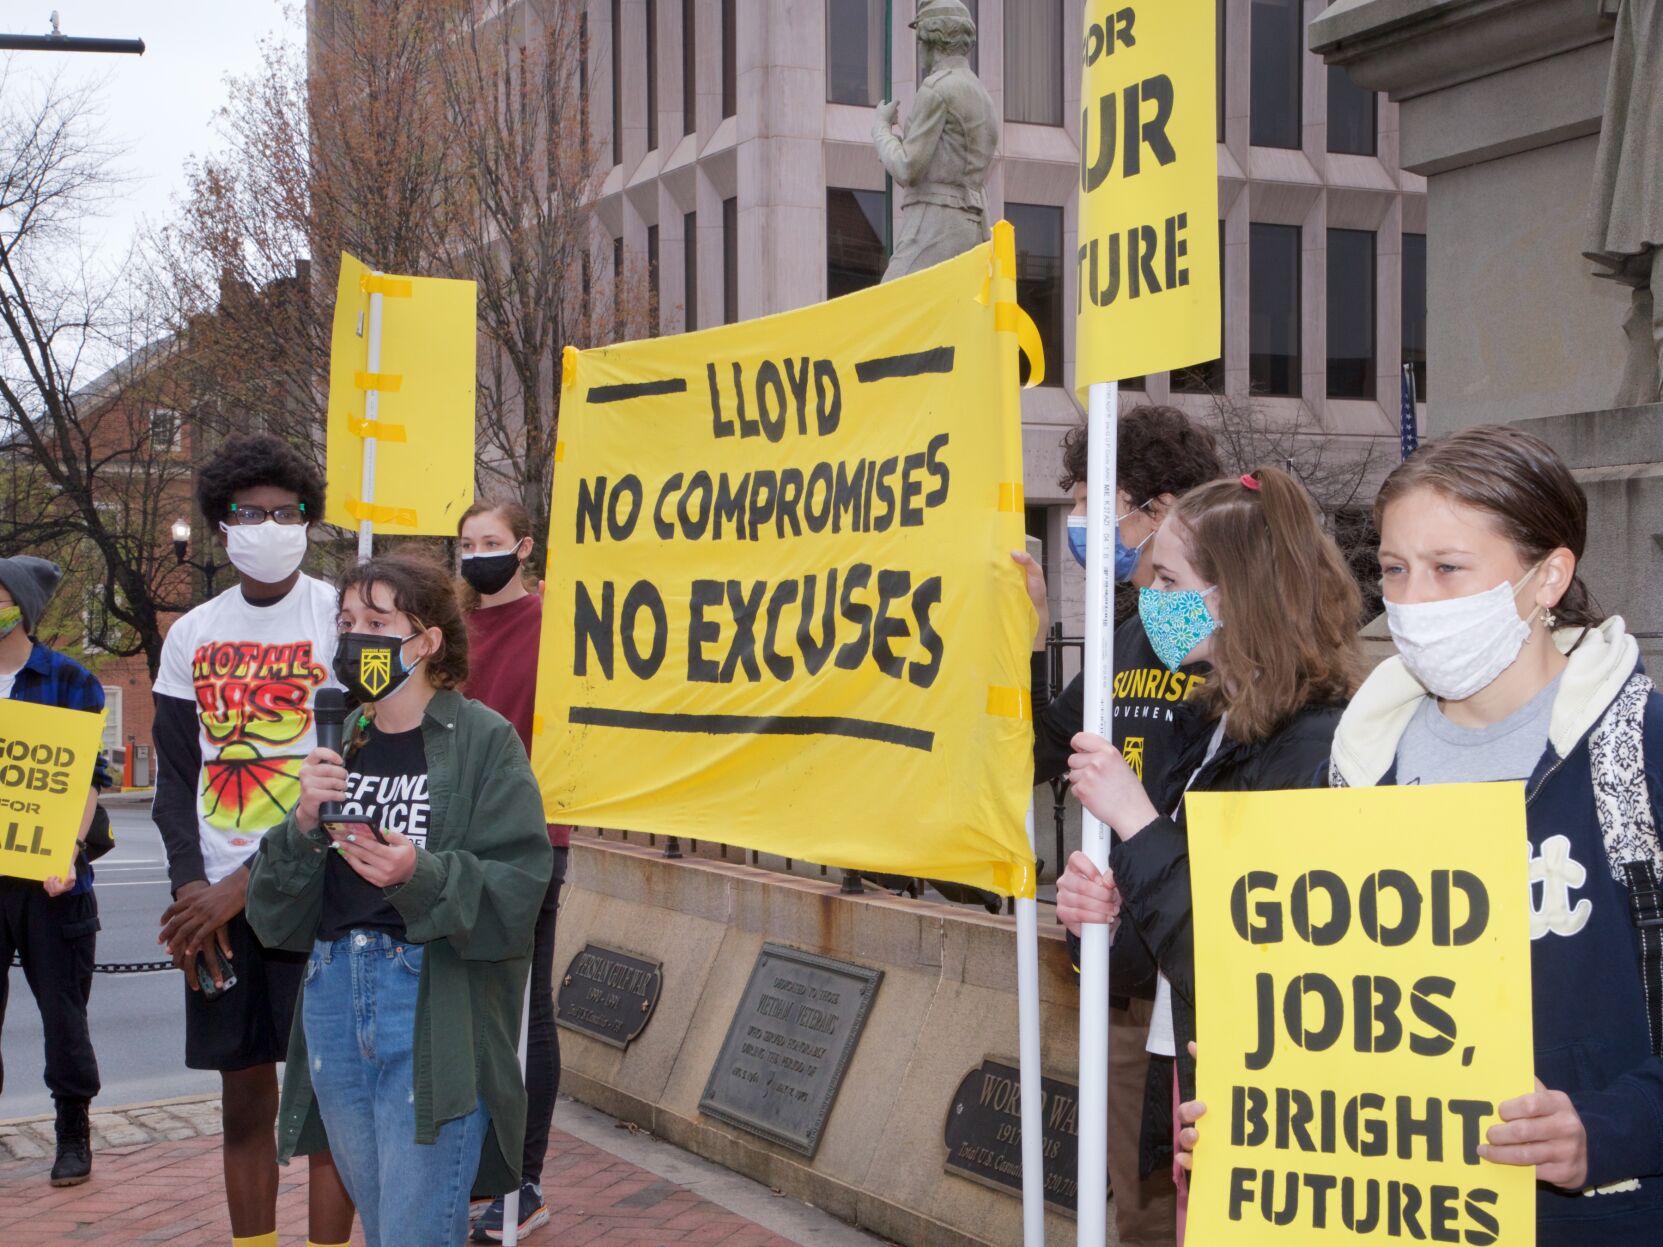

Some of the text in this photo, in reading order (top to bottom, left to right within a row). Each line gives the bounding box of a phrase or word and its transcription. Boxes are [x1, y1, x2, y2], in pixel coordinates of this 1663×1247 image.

[1083, 7, 1136, 68] OR
[1082, 74, 1176, 194] UR
[1077, 212, 1190, 315] TURE
[707, 357, 842, 443] LLOYD
[576, 433, 949, 544] NO COMPROMISES
[573, 562, 944, 688] NO EXCUSES
[192, 641, 328, 687] NOT ME,
[195, 680, 313, 746] US
[1114, 706, 1174, 722] OVEMEN
[0, 764, 70, 794] OBS
[344, 772, 430, 804] EFUND
[0, 822, 52, 857] LL
[1230, 869, 1490, 947] GOOD
[576, 953, 652, 996] PERSIAN GULF WAR
[757, 993, 840, 1035] VIETNAM VETERANS
[1245, 972, 1476, 1071] JOBS,
[979, 1074, 1079, 1137] WOR WA
[996, 1122, 1022, 1146] 1917
[1230, 1085, 1494, 1165] BRIGHT
[1228, 1166, 1500, 1247] FUTURES
